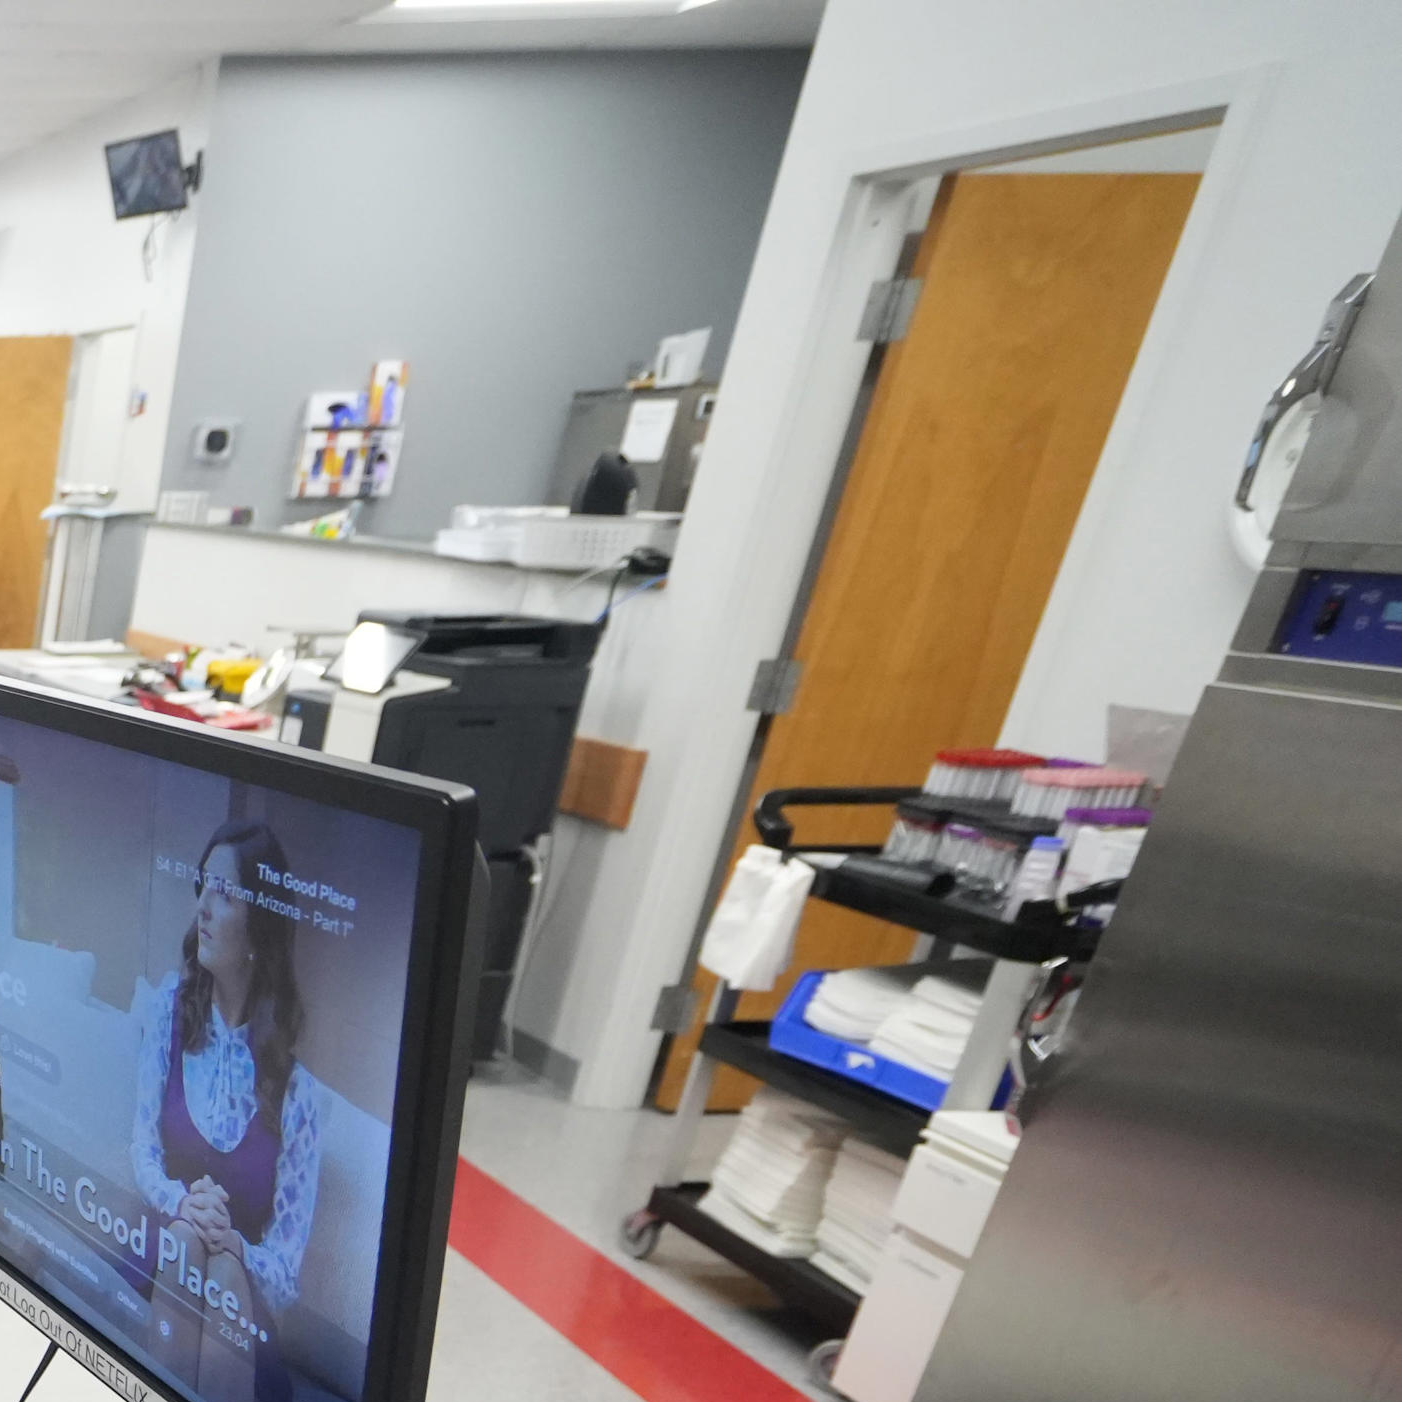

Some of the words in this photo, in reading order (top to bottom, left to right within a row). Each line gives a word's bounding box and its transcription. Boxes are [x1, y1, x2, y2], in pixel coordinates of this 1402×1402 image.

[203, 872, 222, 891] Girl
[223, 879, 254, 903] From
[257, 892, 301, 921] Arizona
[313, 911, 340, 936] Part
[257, 863, 280, 886] The
[283, 872, 317, 898] Good
[319, 885, 356, 911] Place
[21, 1137, 67, 1204] The
[75, 1176, 148, 1260] Good
[157, 1226, 268, 1342] Place...
[13, 1288, 36, 1322] Log
[39, 1309, 63, 1339] Out
[66, 1330, 82, 1358] Of
